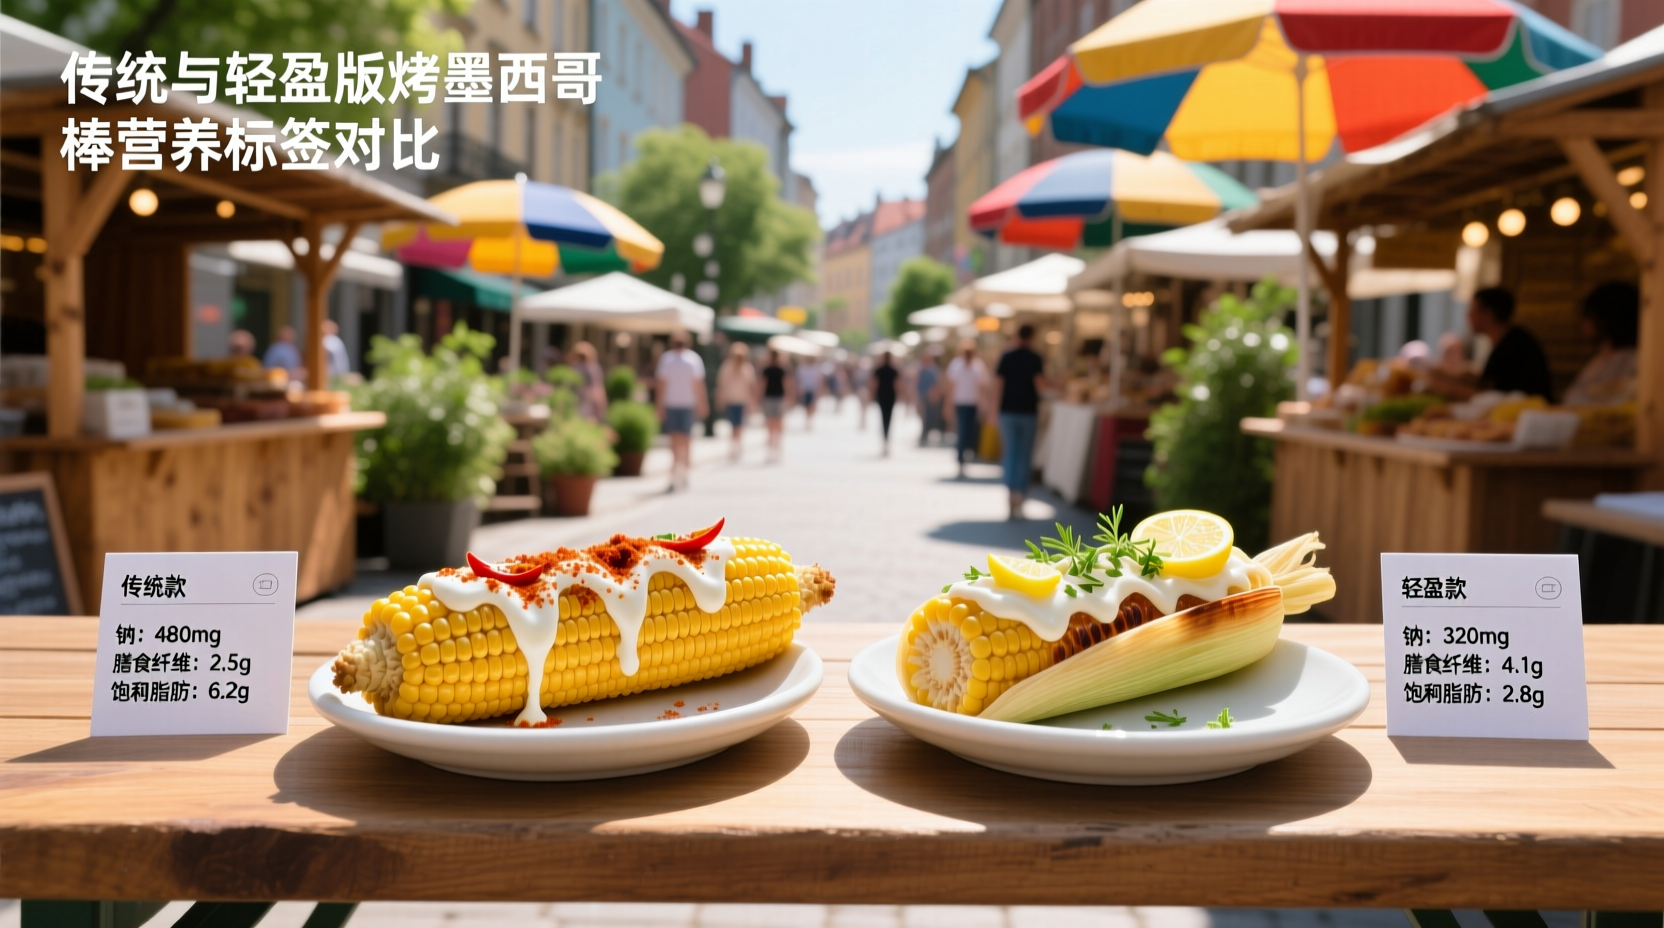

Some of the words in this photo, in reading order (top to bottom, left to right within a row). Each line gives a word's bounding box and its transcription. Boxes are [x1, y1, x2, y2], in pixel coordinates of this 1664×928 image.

[121, 574, 187, 598] 传统款
[1401, 575, 1467, 600] 轻盈款
